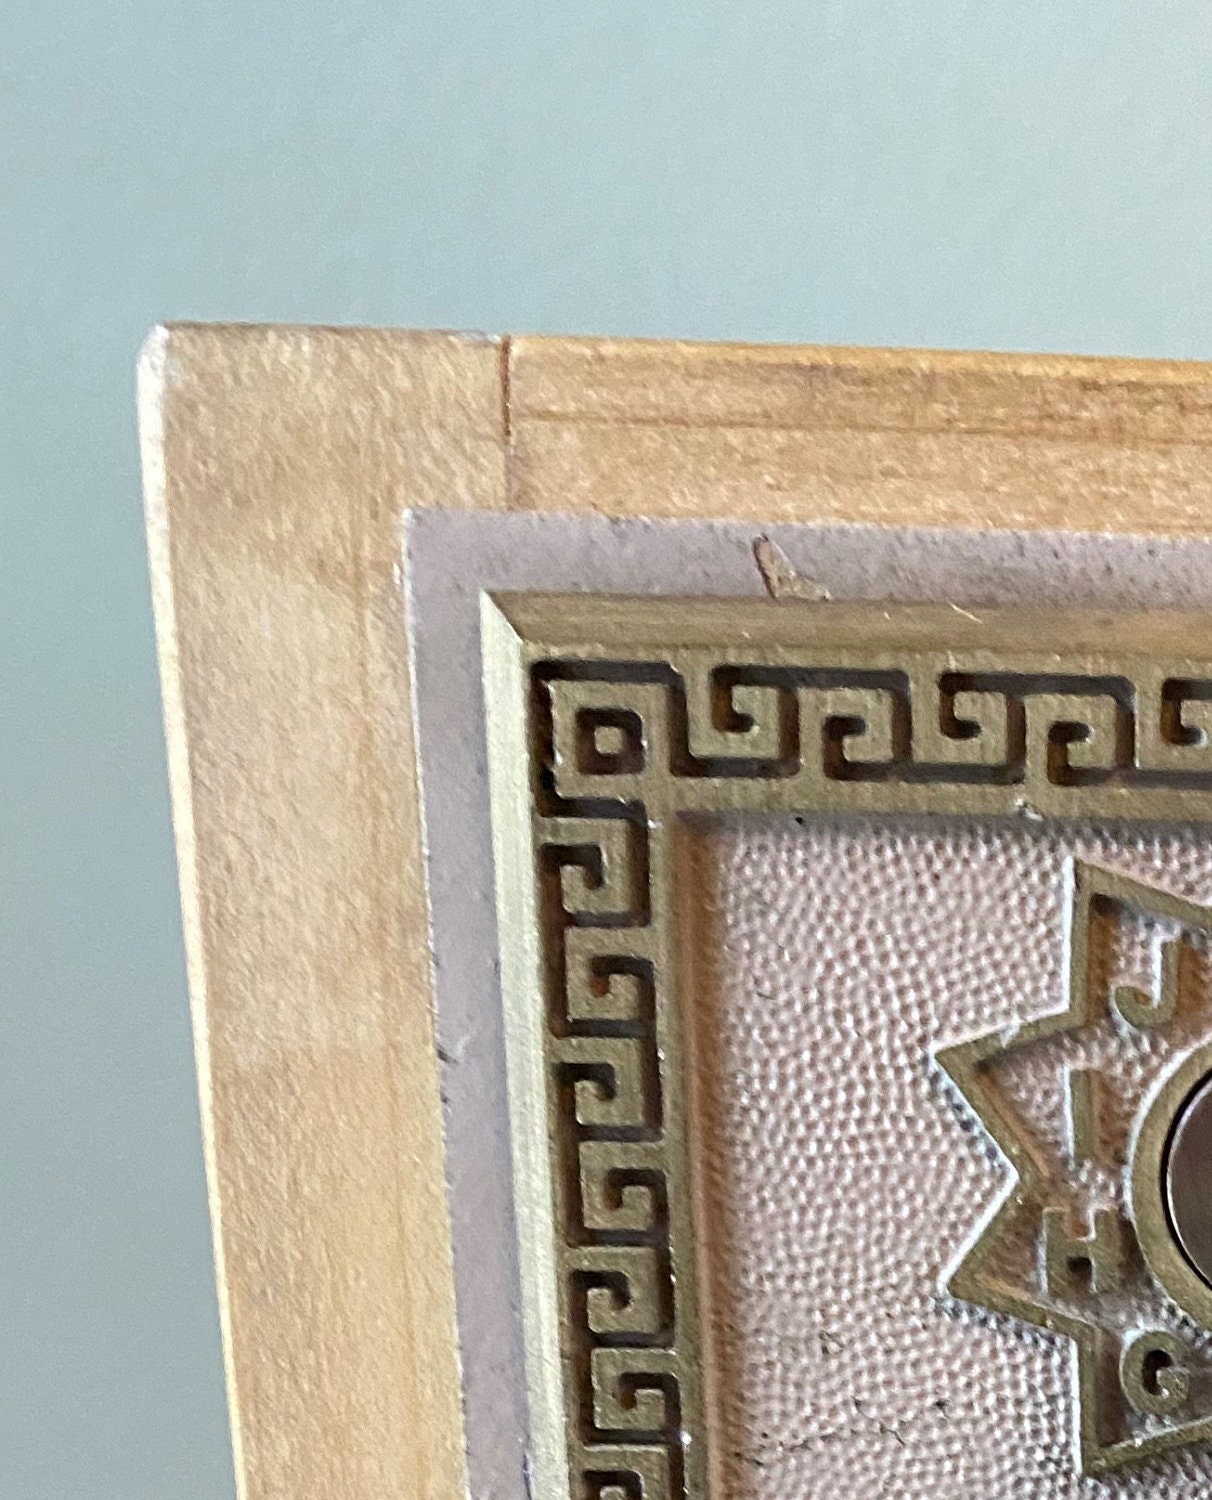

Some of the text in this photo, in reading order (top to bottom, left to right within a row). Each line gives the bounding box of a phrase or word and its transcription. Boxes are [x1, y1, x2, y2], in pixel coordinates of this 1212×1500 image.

[1108, 936, 1180, 1032] J
[1063, 1066, 1094, 1166] I
[1040, 1207, 1118, 1296] H
[1119, 1328, 1190, 1414] G
